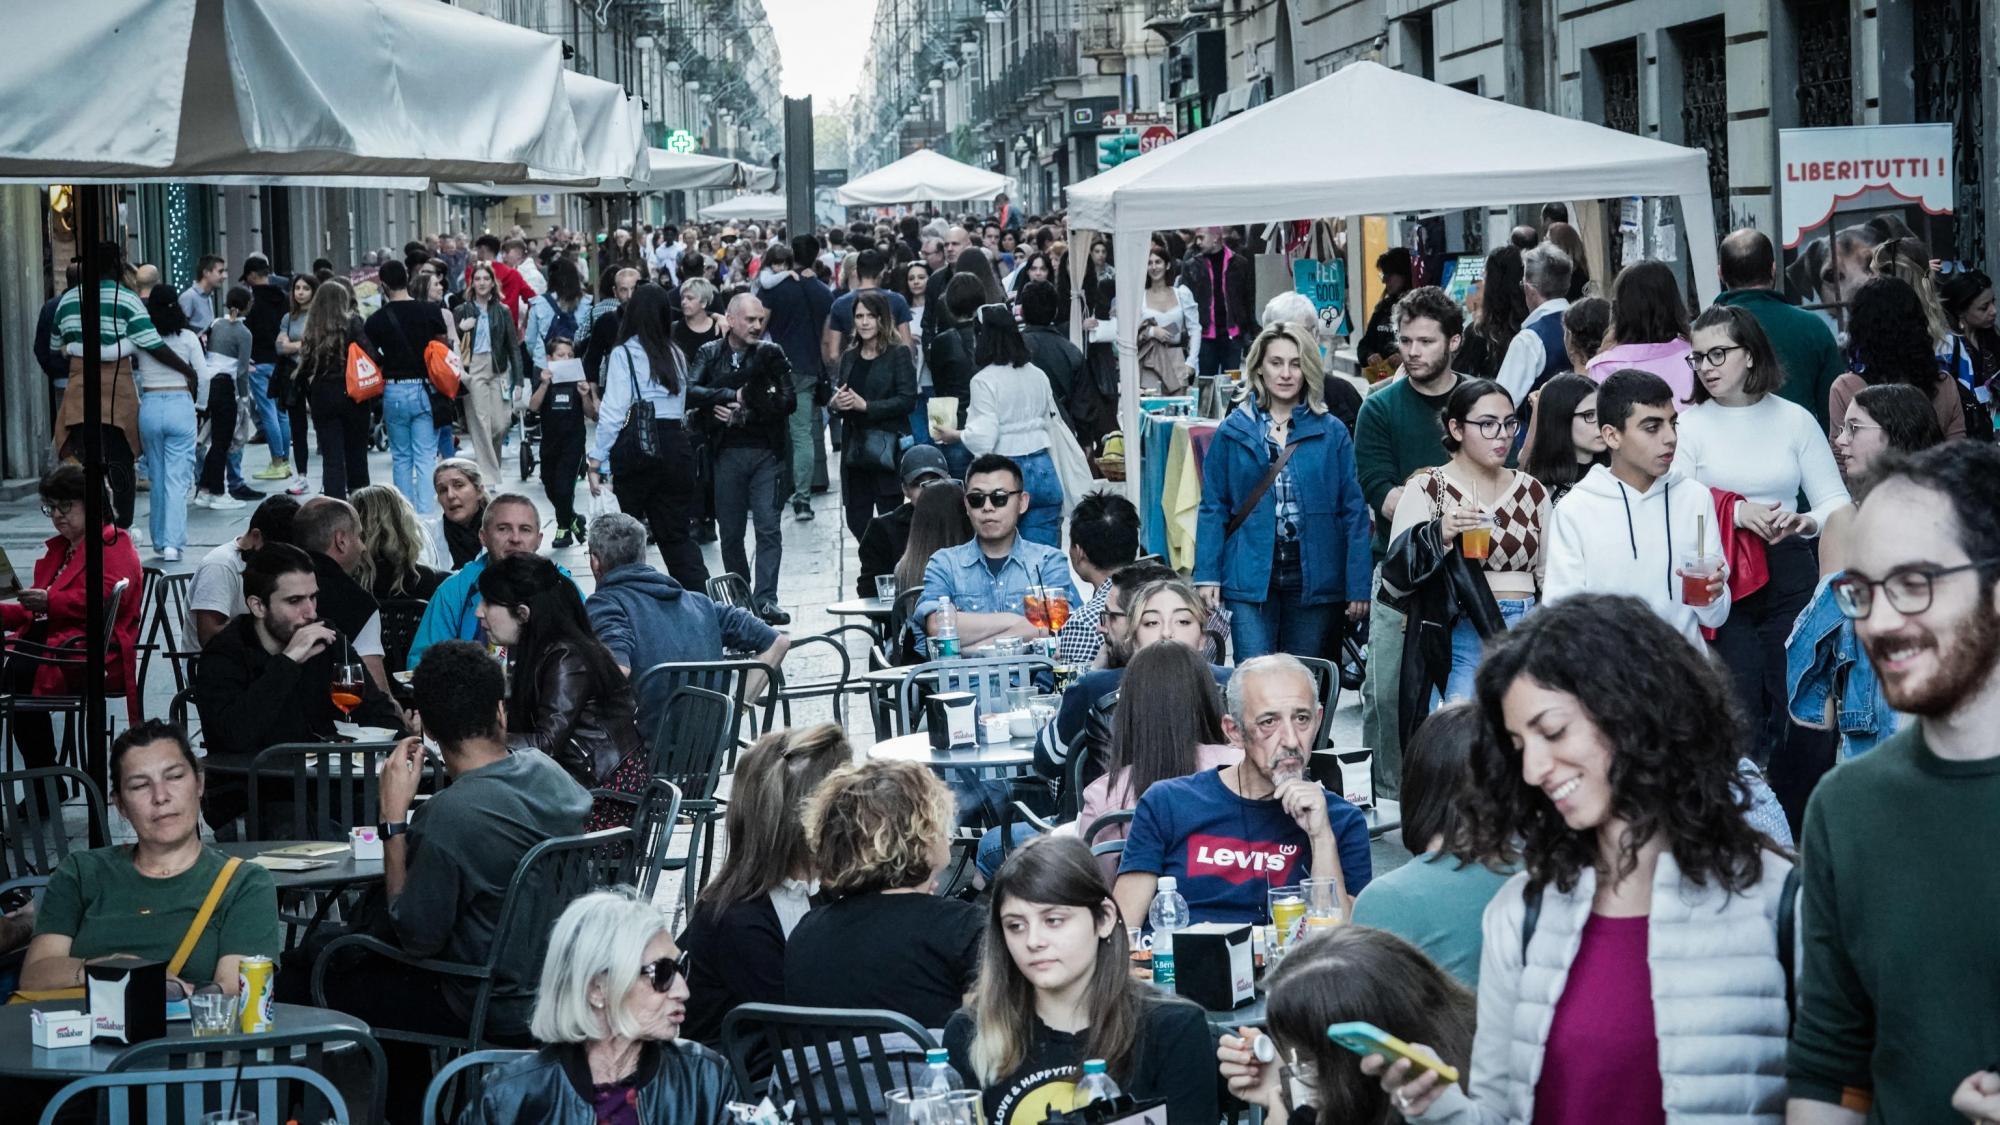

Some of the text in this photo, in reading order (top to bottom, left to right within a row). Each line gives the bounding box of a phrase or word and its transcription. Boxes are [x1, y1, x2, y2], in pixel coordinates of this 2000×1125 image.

[1787, 158, 1945, 182] LIBERITUTTI !
[56, 1028, 83, 1038] malabar
[97, 1020, 125, 1031] malabar
[994, 1094, 1013, 1125] LOVE
[1011, 1085, 1021, 1096] &
